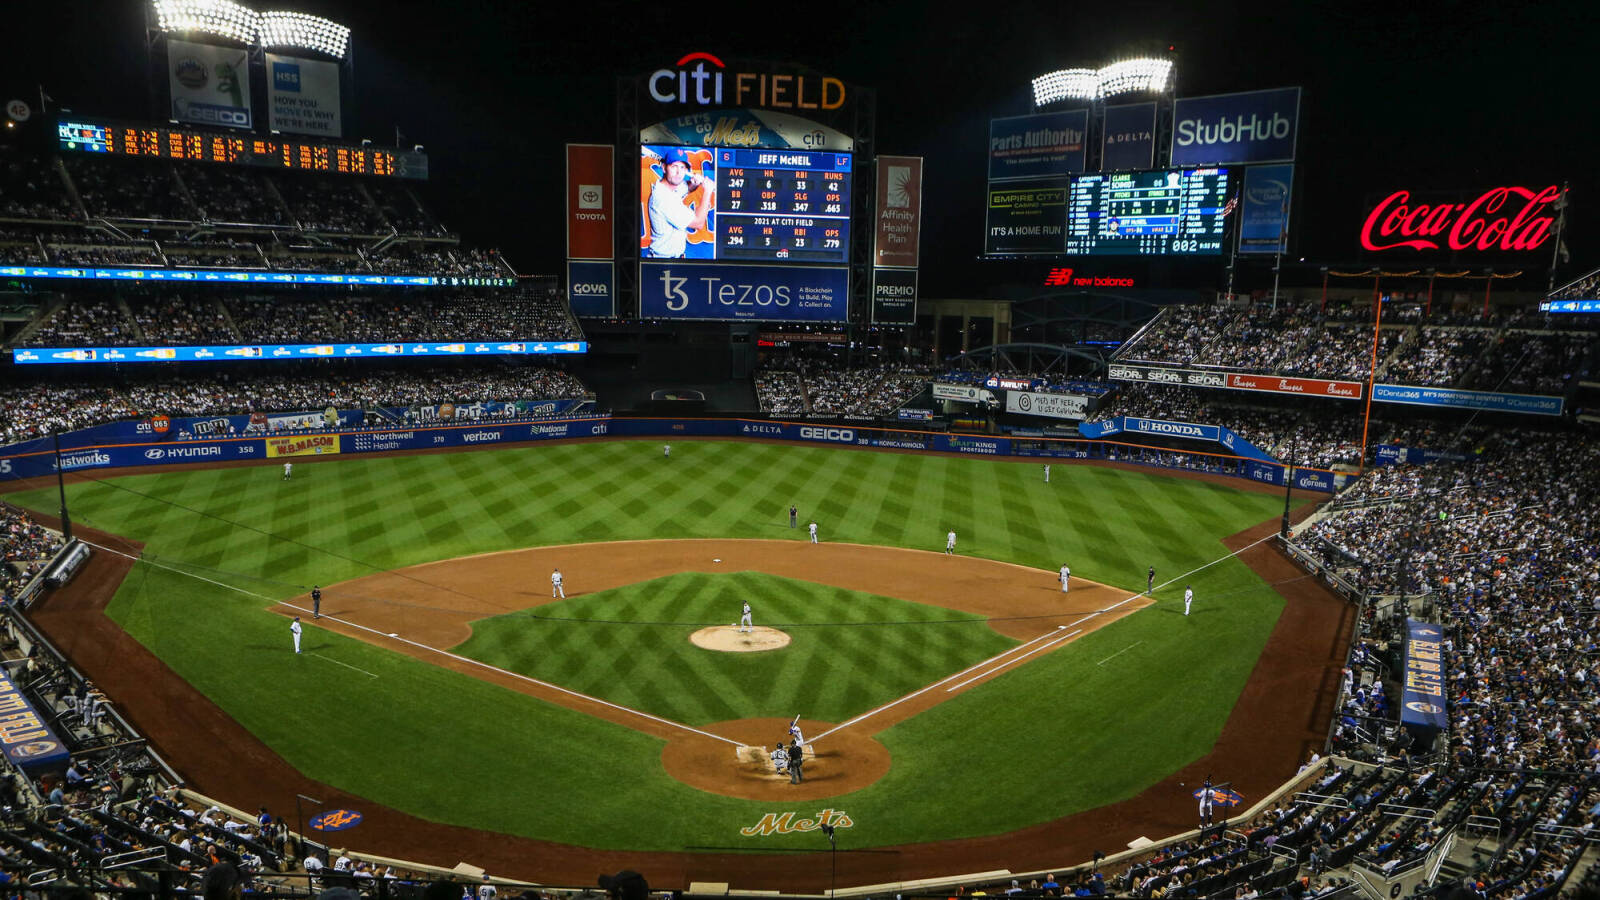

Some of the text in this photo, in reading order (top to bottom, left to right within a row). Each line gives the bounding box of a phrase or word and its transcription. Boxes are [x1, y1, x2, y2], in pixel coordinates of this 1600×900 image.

[276, 72, 298, 82] HSS
[736, 74, 846, 110] FIELD
[274, 96, 317, 108] HOW YOU
[11, 105, 26, 116] 42
[187, 107, 248, 123] GEICO
[275, 108, 335, 120] MOVE IS WHY
[276, 118, 304, 128] WE'RE
[678, 114, 710, 127] LET'S
[696, 124, 712, 134] GO
[704, 117, 760, 145] Mets
[1176, 112, 1289, 146] StubHub
[802, 131, 825, 146] citi
[992, 128, 1082, 150] Parts Authority
[1118, 132, 1150, 142] DELTA
[758, 154, 811, 166] JEFF McNEIL
[728, 179, 744, 188] .247
[766, 180, 771, 188] 6
[829, 183, 838, 191] 42
[994, 193, 1060, 203] EMPIRE CITY
[732, 201, 740, 209] 27
[761, 202, 776, 210] .318
[792, 204, 808, 212] .347
[576, 213, 606, 221] TOYOTA
[881, 210, 914, 221] Affinity
[1360, 185, 1566, 252] Coca-Cola
[883, 223, 912, 232] Health
[991, 226, 1061, 236] IT'S A HOME RUN
[728, 237, 743, 245] .294
[795, 239, 804, 247] 23
[888, 234, 906, 243] Plan
[824, 240, 839, 248] .779
[1074, 276, 1134, 287] new balance
[574, 284, 607, 294] GOYA
[700, 278, 791, 307] Tezos
[876, 286, 914, 295] PREMIO
[1383, 390, 1420, 399] Dental365
[1513, 399, 1556, 409] Dental365
[137, 421, 151, 430] citi
[539, 425, 567, 433] National
[592, 423, 606, 434] citi
[753, 426, 781, 434] DELTA
[1151, 423, 1203, 436] HONDA
[373, 432, 413, 441] Northwell
[464, 431, 500, 442] verizon
[800, 427, 853, 441] GEICO
[373, 442, 399, 450] Health
[879, 440, 900, 448] KONICA
[949, 439, 996, 448] DRAFTKINGS
[168, 447, 221, 457] HYUNDAI
[239, 446, 254, 454] 358
[53, 452, 110, 468] Justworks
[1254, 470, 1272, 481] rts rts
[1300, 478, 1327, 488] Corona
[740, 808, 854, 836] Mets
